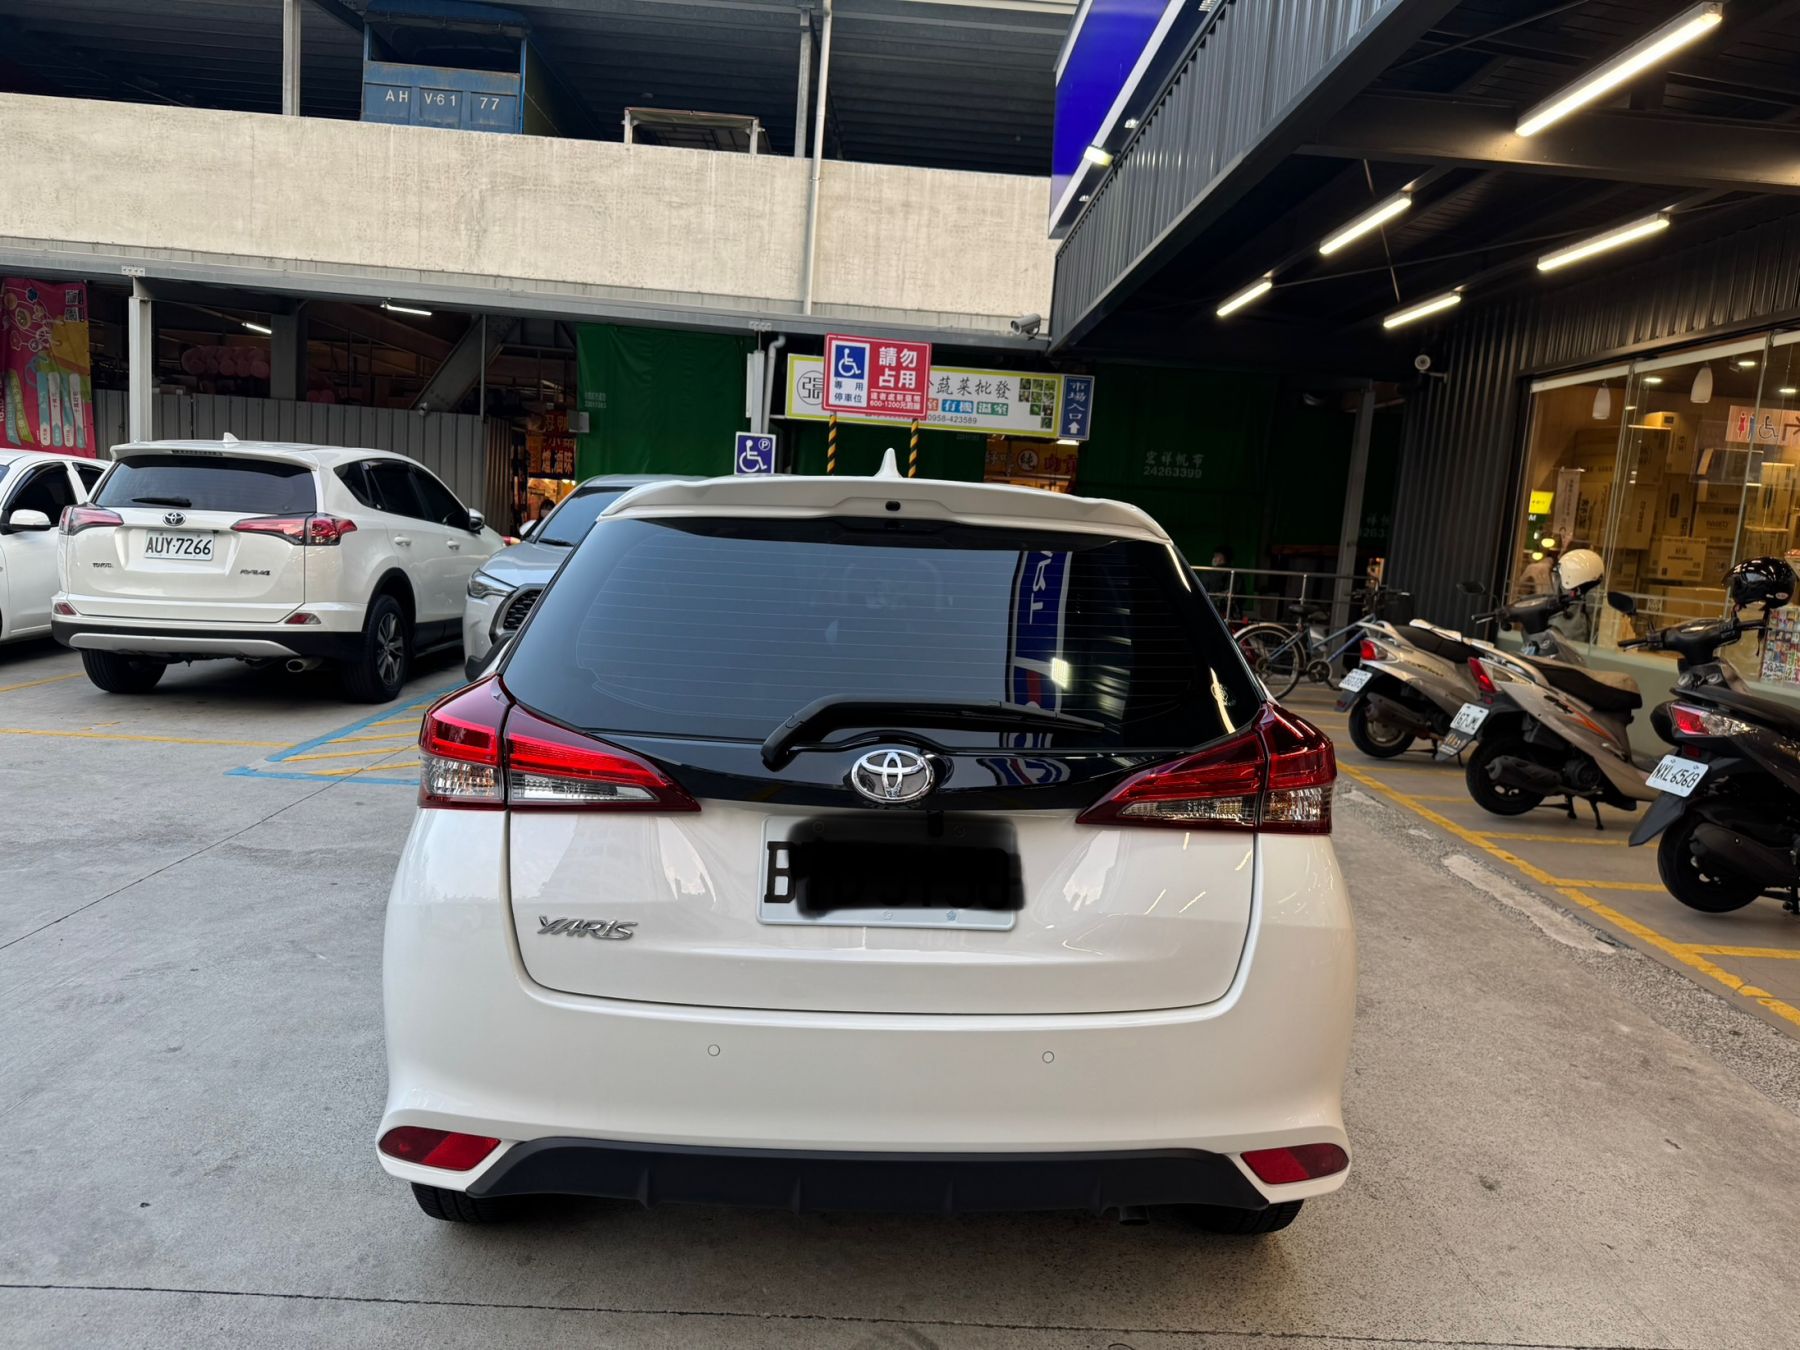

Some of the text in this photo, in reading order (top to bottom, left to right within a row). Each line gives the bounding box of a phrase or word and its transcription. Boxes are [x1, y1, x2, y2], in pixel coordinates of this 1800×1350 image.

[385, 89, 408, 103] AH
[480, 97, 499, 111] 77
[878, 346, 917, 369] 請勿
[878, 367, 916, 389] 占用
[929, 374, 1010, 400] 蔬菜批發
[834, 391, 862, 403] 停車位
[1068, 381, 1088, 420] 市場入口
[537, 915, 639, 941] YARIS
